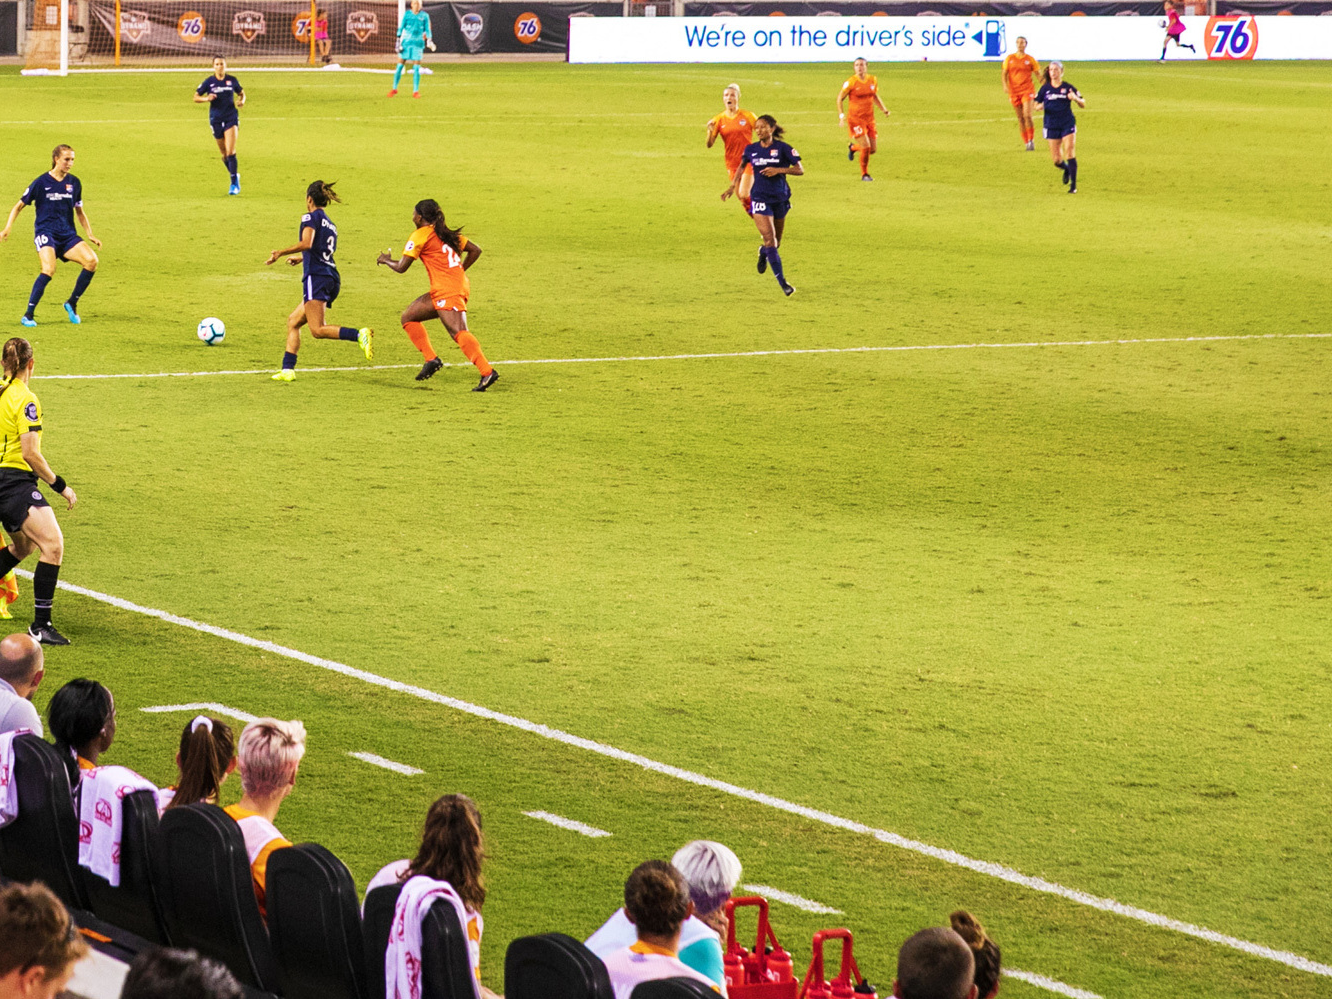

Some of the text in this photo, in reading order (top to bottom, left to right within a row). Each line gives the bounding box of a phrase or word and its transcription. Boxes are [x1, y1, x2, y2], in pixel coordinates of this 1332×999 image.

[181, 17, 202, 36] 76
[460, 23, 483, 32] DASH
[518, 19, 538, 36] 76
[685, 24, 966, 47] We're on the driver's side
[1212, 19, 1251, 56] 76
[34, 234, 49, 252] 16
[322, 235, 335, 261] 3
